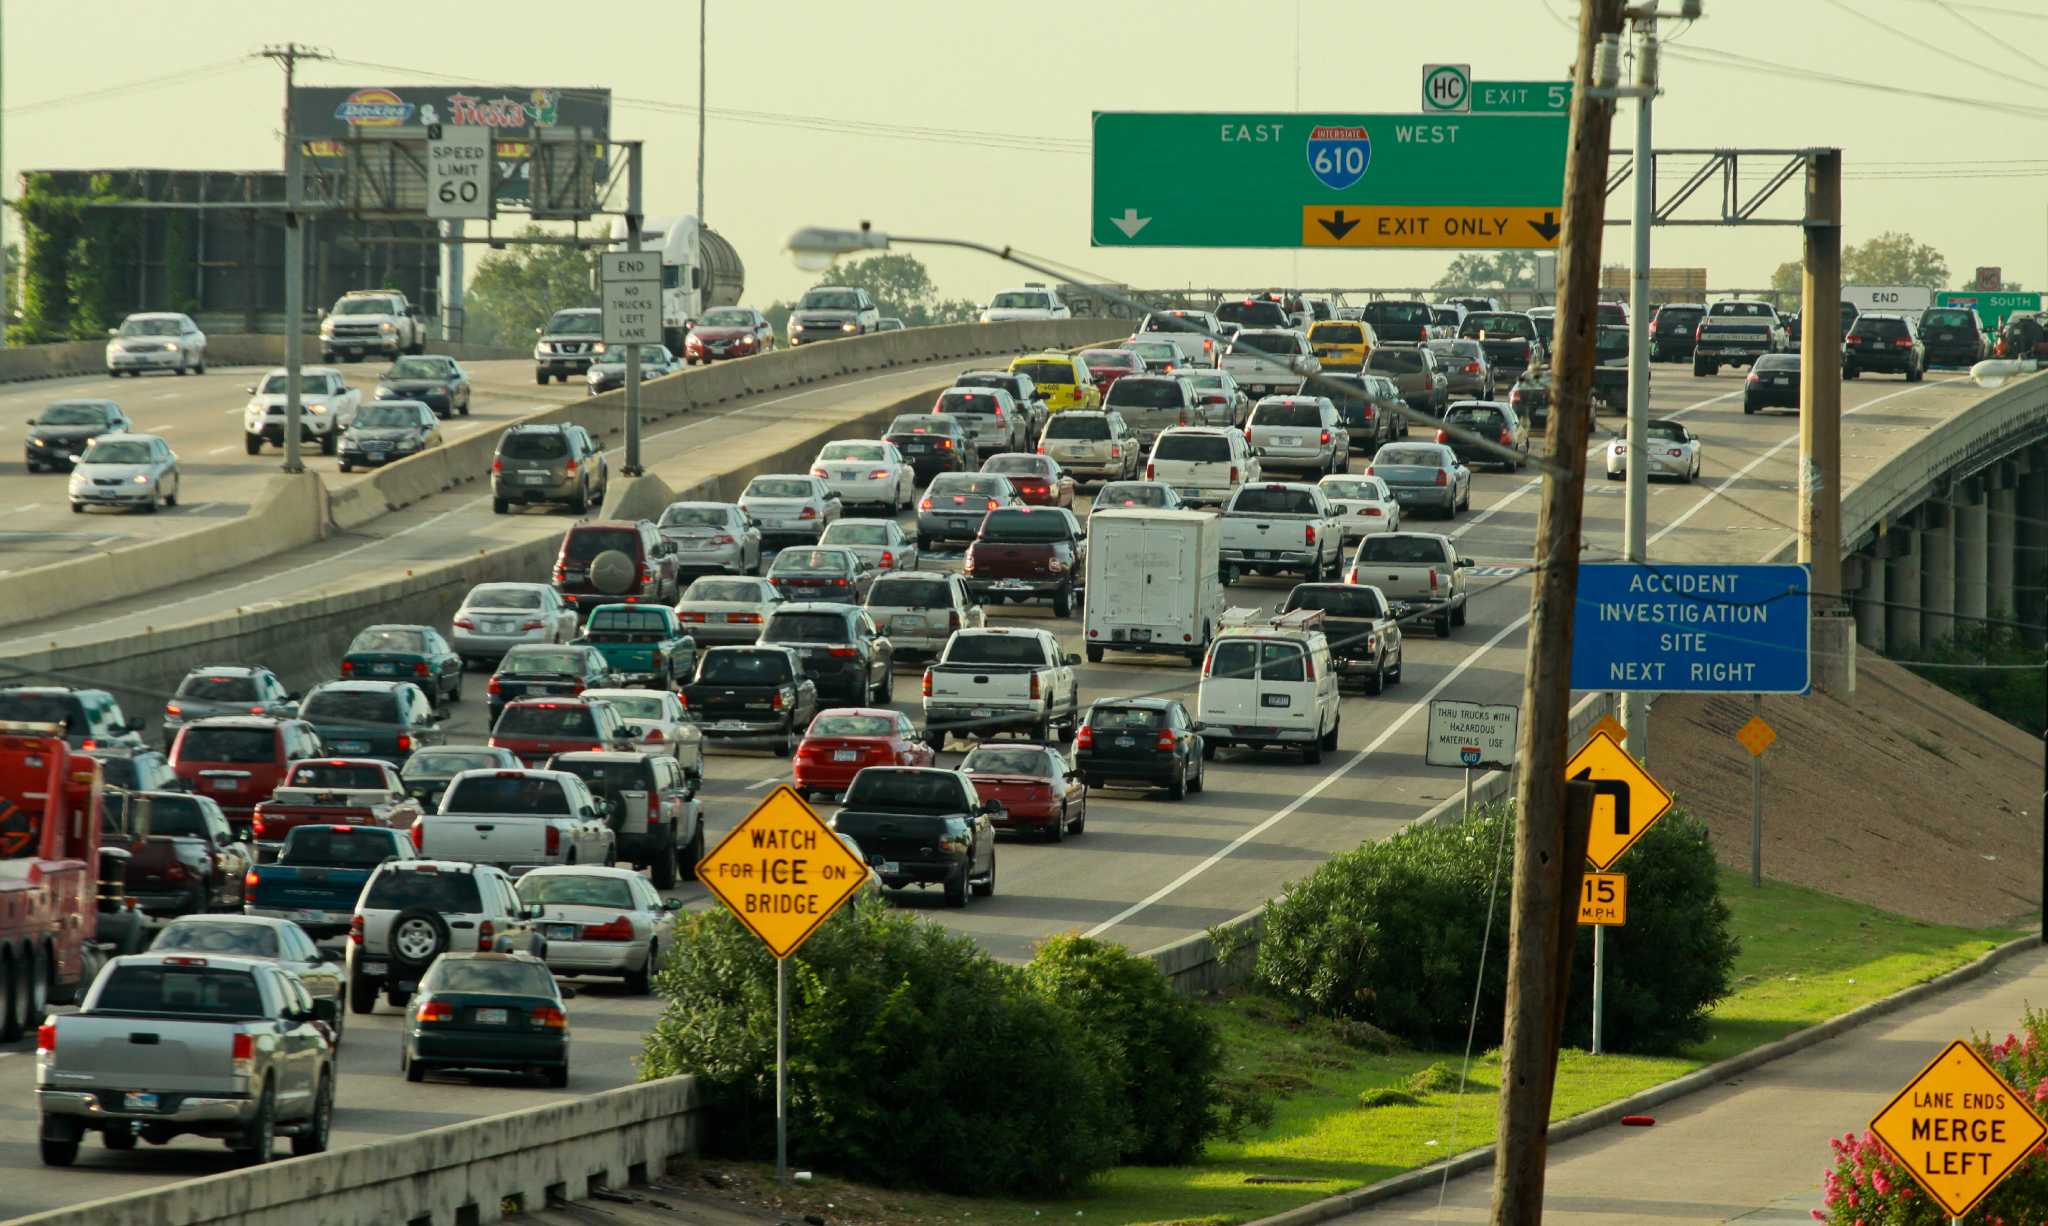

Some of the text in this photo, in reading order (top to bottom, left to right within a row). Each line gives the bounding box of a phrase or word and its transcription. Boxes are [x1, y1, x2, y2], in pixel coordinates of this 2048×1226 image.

[1433, 77, 1460, 99] HC
[1485, 86, 1576, 108] EXIT 5
[421, 103, 440, 125] &
[448, 91, 526, 128] Fiesta
[1221, 124, 1284, 142] EAST
[1317, 129, 1361, 139] INTERSTATE
[1395, 125, 1459, 143] WEST
[432, 146, 484, 160] SPEED
[1314, 147, 1364, 174] 610
[437, 163, 478, 177] LIMIT
[438, 180, 479, 203] 60
[1377, 217, 1508, 236] EXIT ONLY
[618, 260, 645, 273] END
[624, 286, 639, 297] NO
[1872, 292, 1899, 303] END
[611, 300, 652, 310] TRUCKS
[1989, 296, 2032, 307] SOUTH
[619, 314, 645, 324] LEFT
[619, 328, 646, 338] LANE
[1629, 574, 1739, 593] ACCIDENT
[1600, 603, 1768, 623] INVESTIGATION
[1660, 633, 1707, 652] SITE
[1610, 662, 1756, 682] NEXT RIGHT
[1438, 707, 1511, 722] THRU TRUCKS WITH
[1450, 722, 1496, 735] HAZARDOUS
[1440, 735, 1504, 748] MATERIALS USE
[1463, 752, 1477, 762] 610
[751, 828, 816, 850] WATCH
[719, 858, 846, 885] FOR ICE ON
[1584, 879, 1616, 903] 15
[745, 893, 819, 914] BRIDGE
[1914, 1091, 2005, 1110] LANE ENDS
[1911, 1117, 2006, 1143] MERGE
[1925, 1151, 1992, 1176] LEFT
